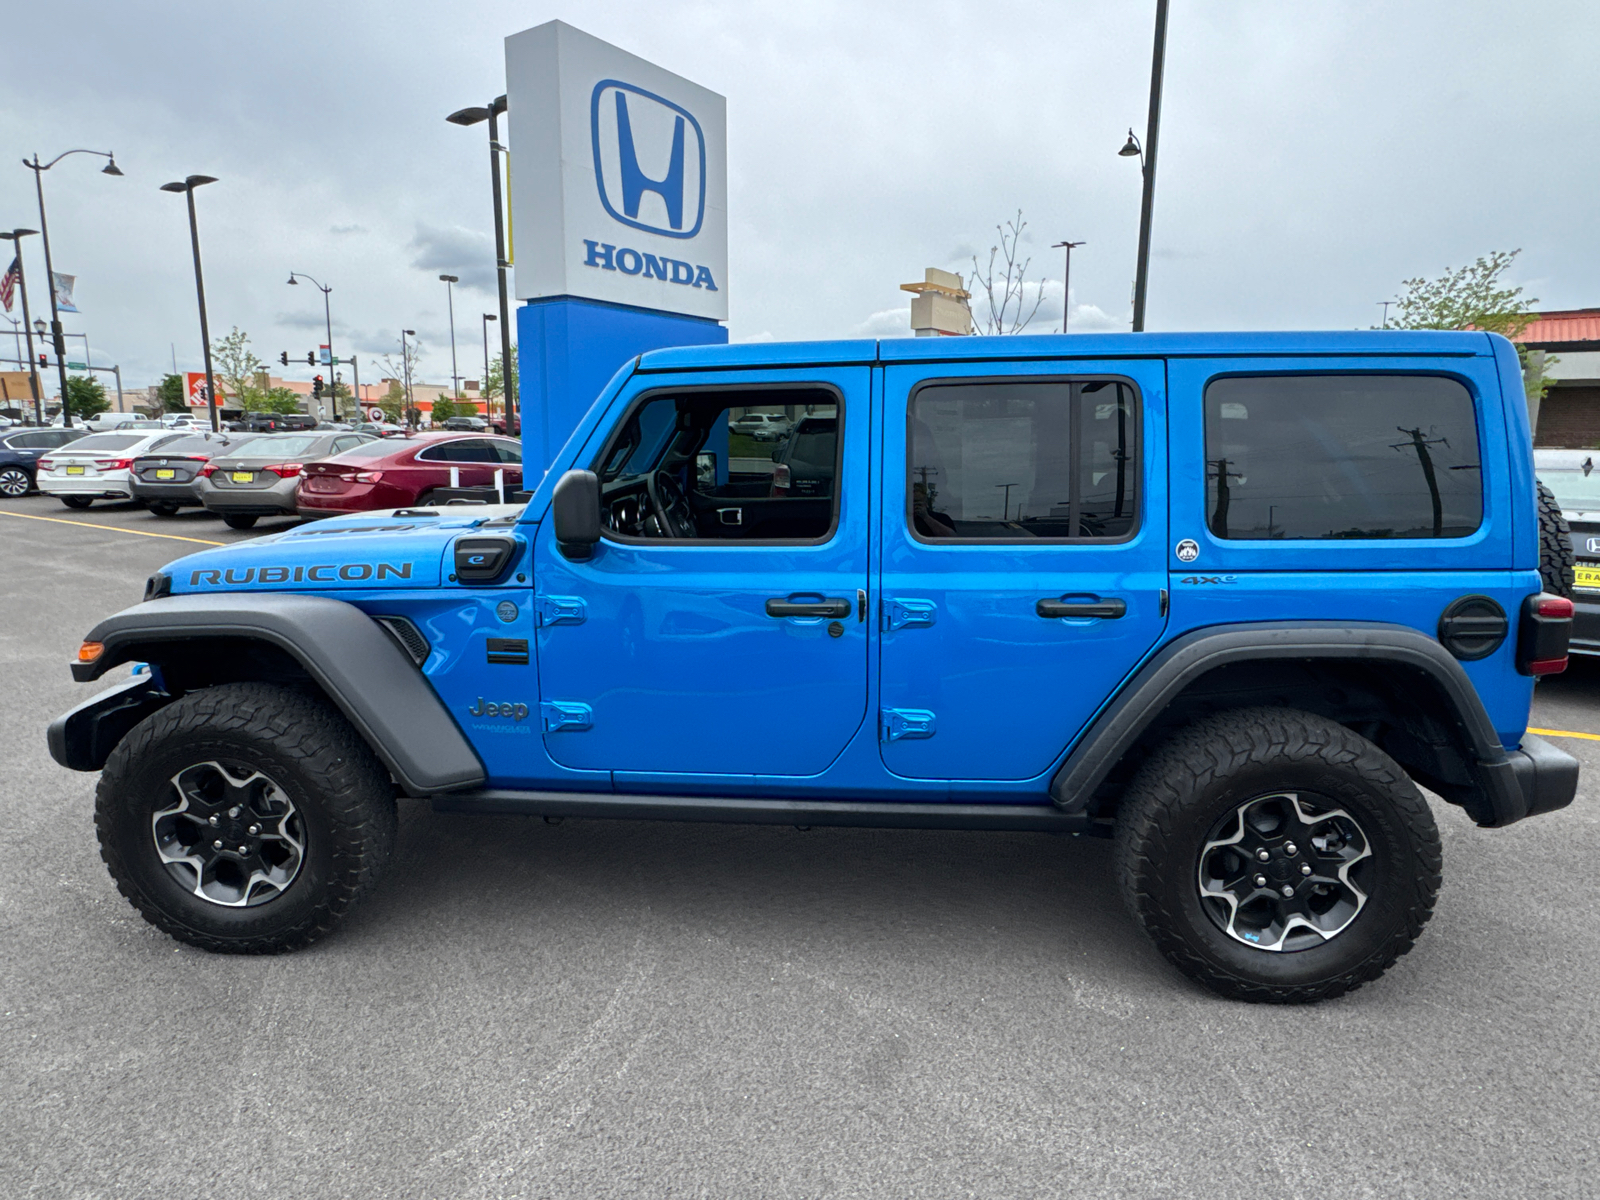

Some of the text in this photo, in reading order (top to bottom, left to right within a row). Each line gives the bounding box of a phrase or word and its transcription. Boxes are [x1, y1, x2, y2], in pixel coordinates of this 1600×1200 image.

[583, 239, 718, 291] HONDA
[190, 563, 412, 586] RUBICON
[469, 696, 529, 721] Jeep
